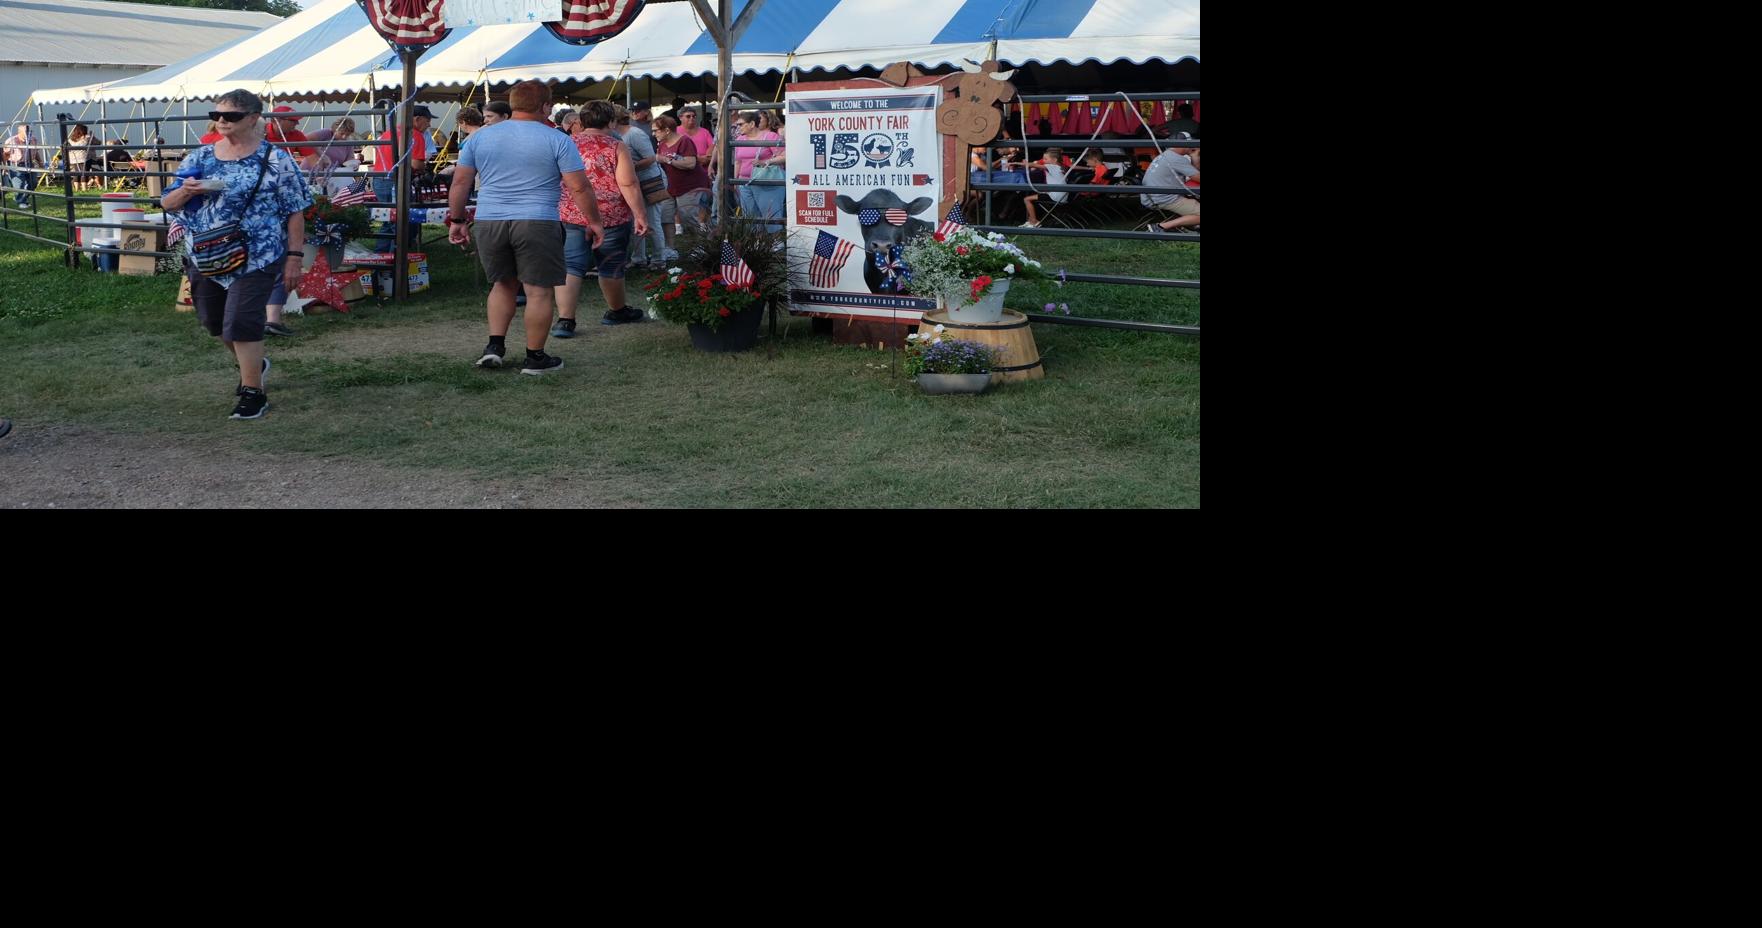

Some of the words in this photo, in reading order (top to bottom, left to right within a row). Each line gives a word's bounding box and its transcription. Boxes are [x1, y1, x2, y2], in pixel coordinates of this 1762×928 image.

[830, 101, 862, 110] WELCOME
[864, 101, 874, 109] TO
[876, 99, 889, 108] THE
[808, 117, 836, 131] YORK
[838, 115, 884, 131] COUNTY
[887, 115, 910, 129] FAIR
[895, 132, 909, 141] TH
[812, 175, 830, 186] ALL
[836, 175, 887, 186] AMERICAN
[891, 174, 910, 186] FUN
[798, 209, 812, 217] SCAN
[804, 216, 829, 224] SCHEDULE
